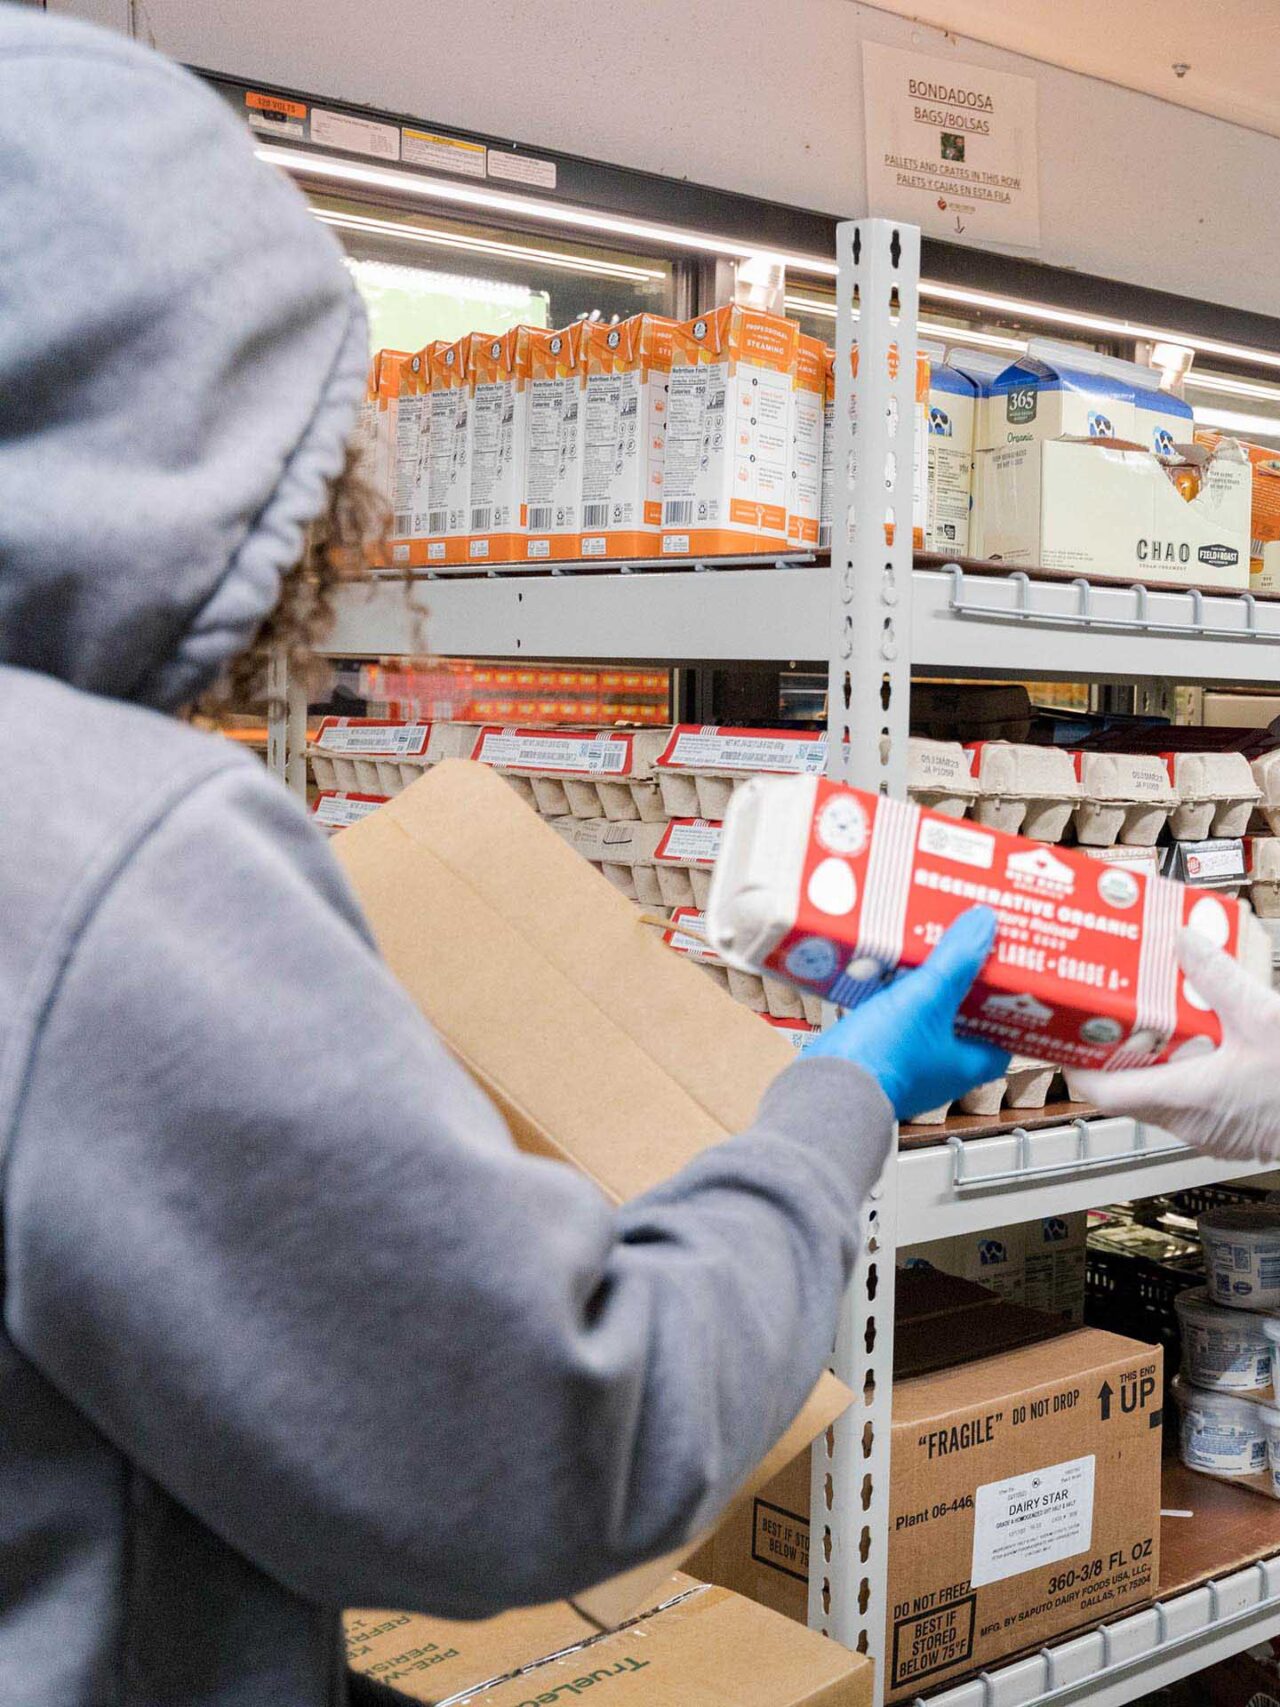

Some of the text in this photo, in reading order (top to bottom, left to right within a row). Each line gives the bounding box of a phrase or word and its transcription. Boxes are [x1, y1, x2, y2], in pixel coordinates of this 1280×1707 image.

[908, 79, 994, 110] BONDADOSA
[914, 106, 990, 132] BAGS/BOLSAS
[884, 154, 1021, 188] PALLETS AND CRATES IN THIS ROW
[897, 174, 927, 187] PALETS
[927, 179, 933, 187] Y
[934, 181, 960, 193] CAJAS
[960, 184, 972, 195] EN
[973, 187, 993, 198] ESTA
[746, 340, 785, 355] STEAMING
[695, 386, 706, 395] 150
[1009, 390, 1034, 411] 365
[1007, 432, 1034, 443] Organic
[1137, 538, 1190, 563] CHAO
[1200, 550, 1238, 562] FIELD ROAST
[914, 868, 1140, 940] REGENERATIVE ORGANIC
[997, 942, 1121, 991] LARGE GRADE A
[1120, 1364, 1156, 1384] THIS END
[1012, 1406, 1026, 1426] DO
[1031, 1398, 1050, 1419] NOT
[1053, 1389, 1080, 1413] DROP
[1120, 1377, 1156, 1414] UP
[1009, 1489, 1069, 1516] DAIRY STAR
[762, 1518, 782, 1538] BEST
[784, 1527, 793, 1541] IF
[895, 1510, 929, 1531] Plant
[769, 1538, 797, 1561] BELOW
[1047, 1538, 1153, 1595] 360-3/8 FL OZ
[894, 1580, 974, 1620] DO NOT FREEZ
[980, 1622, 1002, 1639] MFG.
[1003, 1615, 1017, 1628] BY
[1018, 1600, 1054, 1623] SAPUTO
[1054, 1589, 1081, 1608] DAIRY
[1082, 1578, 1111, 1598] FOODS
[1080, 1590, 1115, 1610] DALLAS,
[1116, 1583, 1128, 1596] TX
[914, 1610, 957, 1640] BEST IF
[912, 1626, 957, 1657] STORED
[382, 1647, 460, 1686] PRE-W
[899, 1637, 967, 1678] BELOW 75°F
